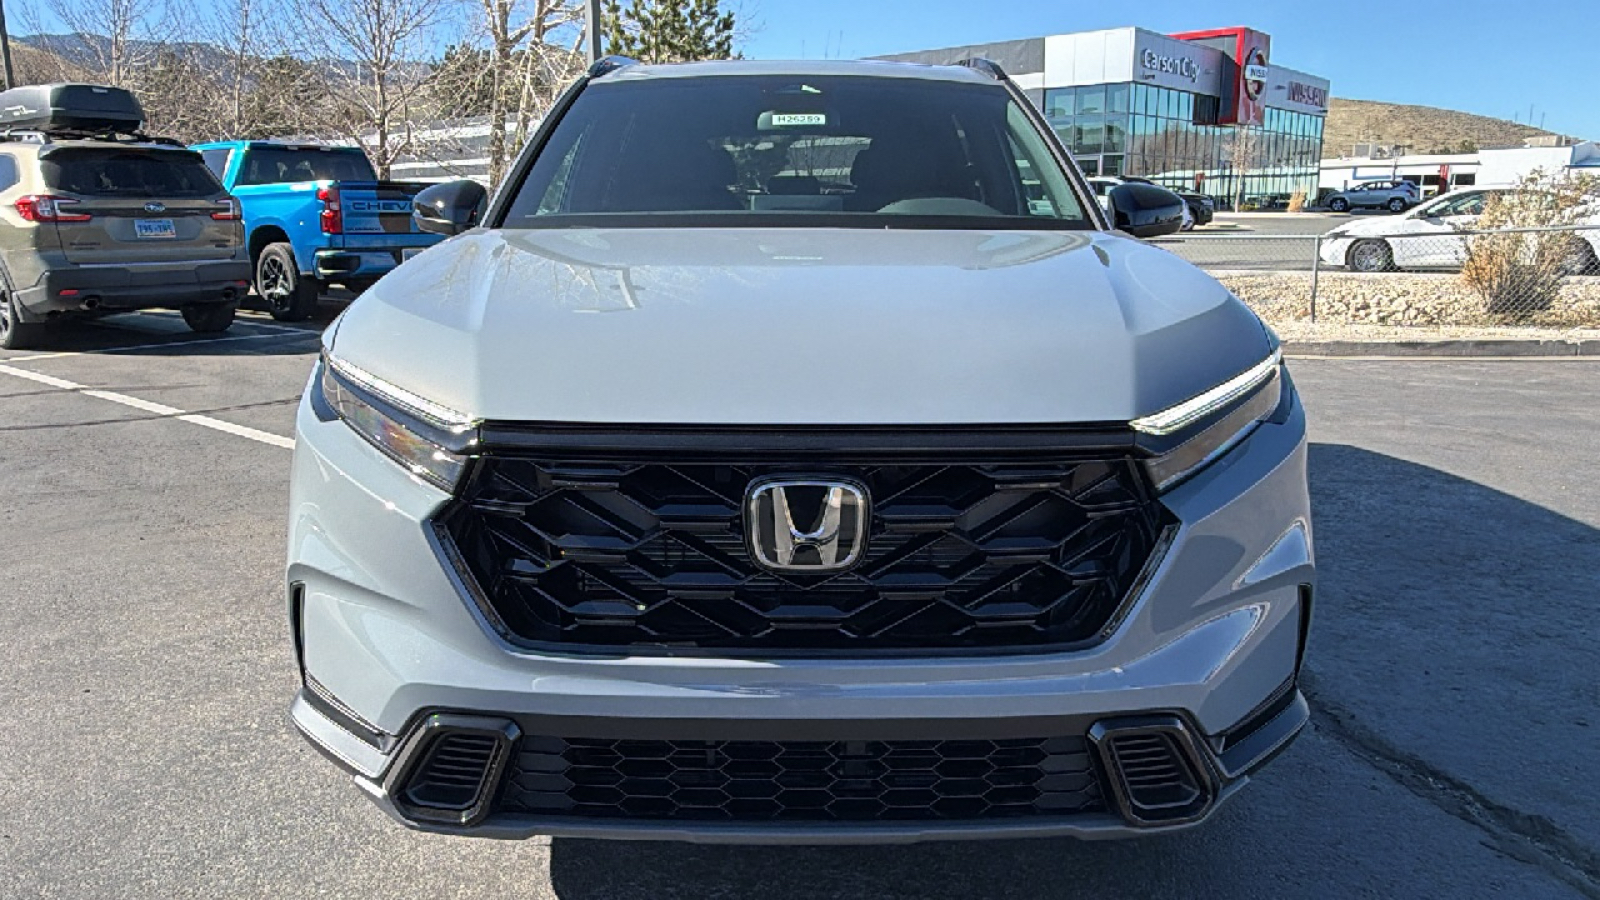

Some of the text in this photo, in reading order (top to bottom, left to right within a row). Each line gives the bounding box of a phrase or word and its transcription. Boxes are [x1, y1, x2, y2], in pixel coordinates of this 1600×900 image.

[1141, 48, 1201, 83] Carson City
[1287, 80, 1328, 108] NISSAN
